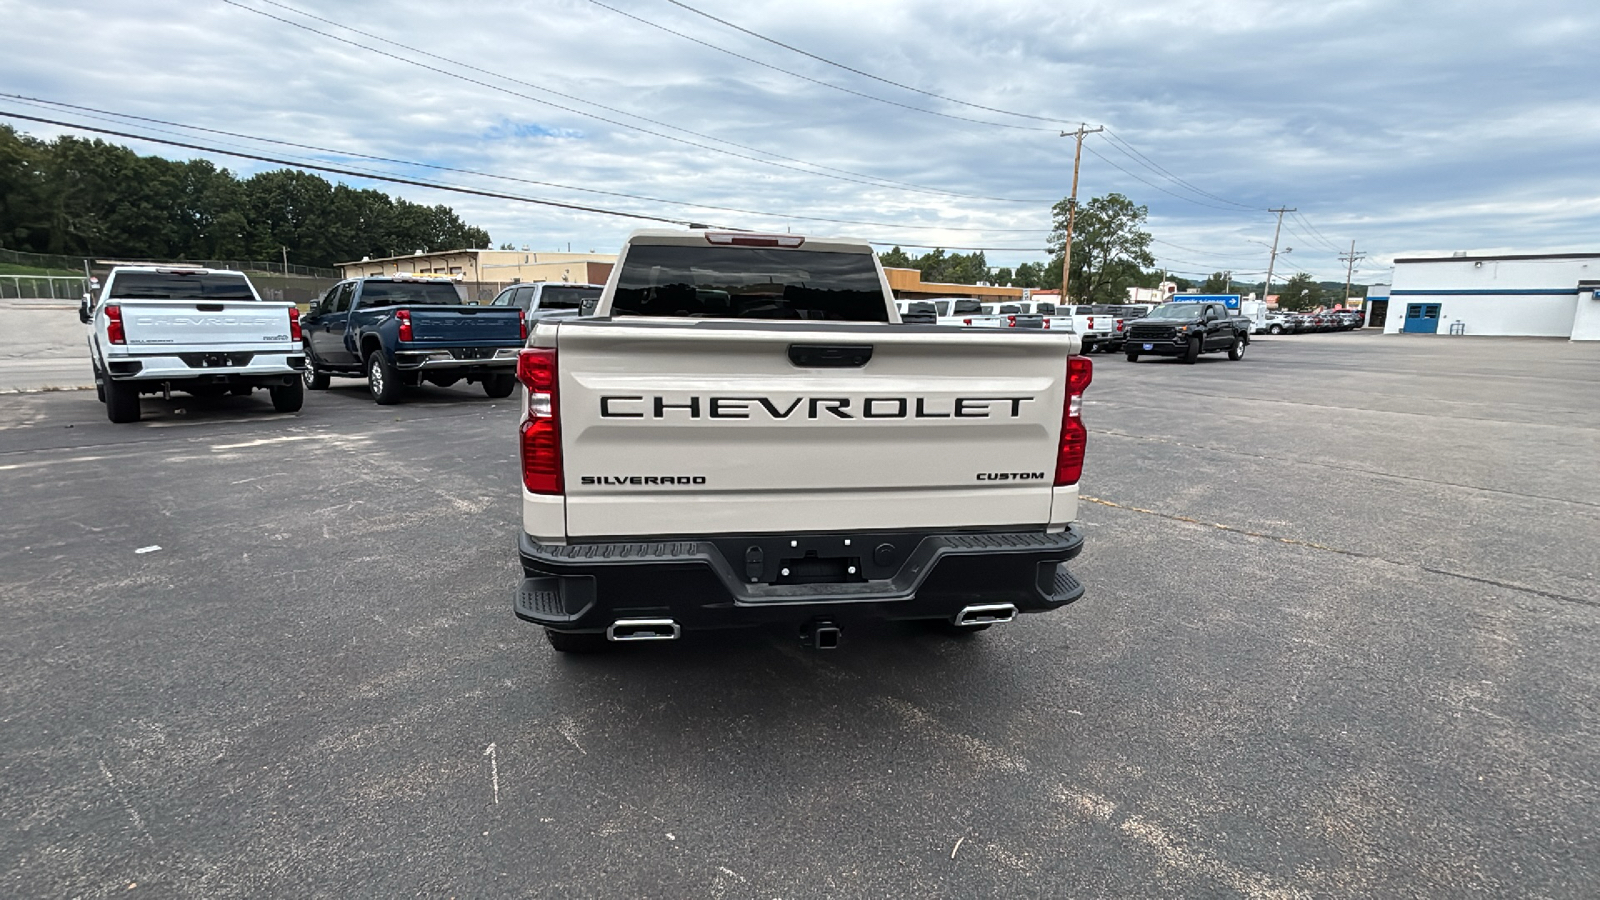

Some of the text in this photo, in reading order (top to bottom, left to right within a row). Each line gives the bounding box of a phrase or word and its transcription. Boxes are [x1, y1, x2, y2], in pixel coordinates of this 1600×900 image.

[136, 318, 280, 326] CHEVROLET
[600, 395, 1035, 419] CHEVROLET
[581, 476, 706, 485] SILVERADO
[976, 472, 1045, 481] CUSTOM
